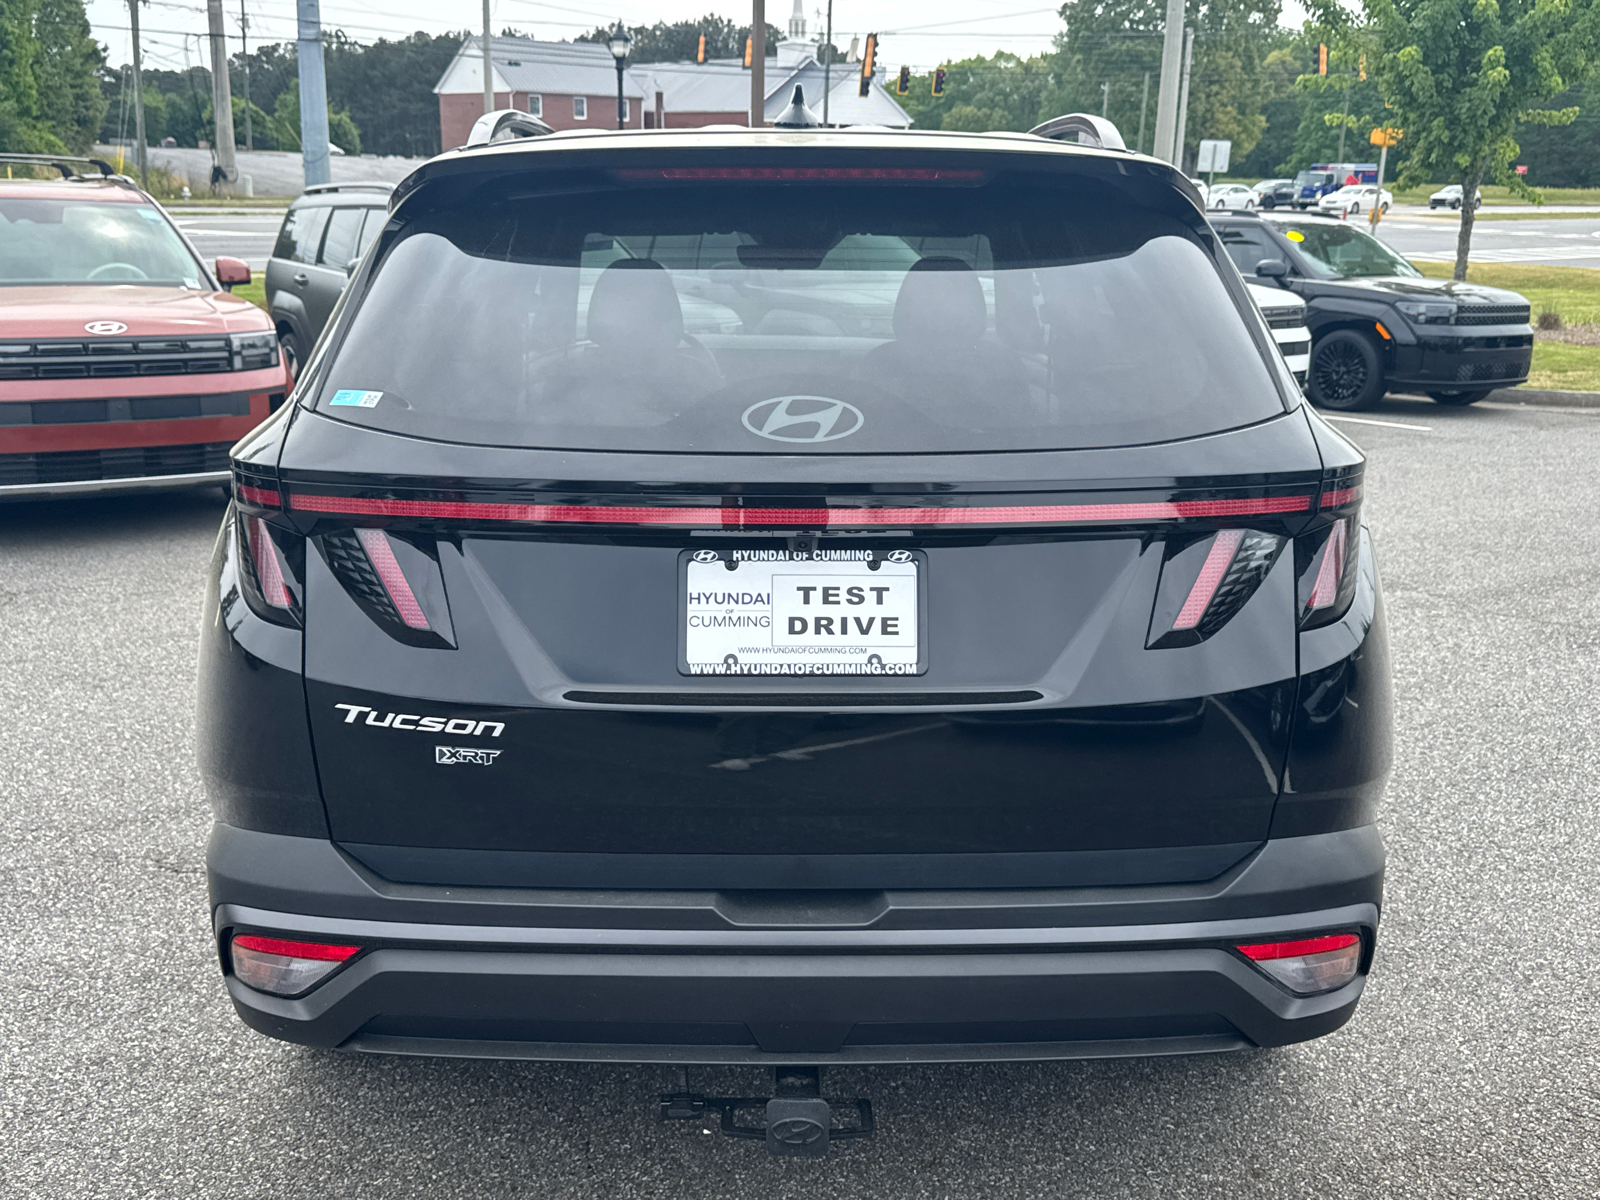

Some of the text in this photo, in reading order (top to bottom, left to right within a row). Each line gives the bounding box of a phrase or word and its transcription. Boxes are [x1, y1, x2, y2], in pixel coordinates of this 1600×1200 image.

[733, 550, 873, 561] HYUNDAI OF CUMMING
[689, 592, 770, 605] HYUNDAI
[796, 586, 890, 605] TEST
[689, 615, 770, 628] CUMMING
[788, 616, 899, 635] DRIVE
[738, 647, 867, 656] WWWHYUNDAIOFCUMMINGCOM
[690, 663, 917, 675] WWW.HYUNDAIOFCUMMING.COM
[435, 745, 504, 766] XRT
